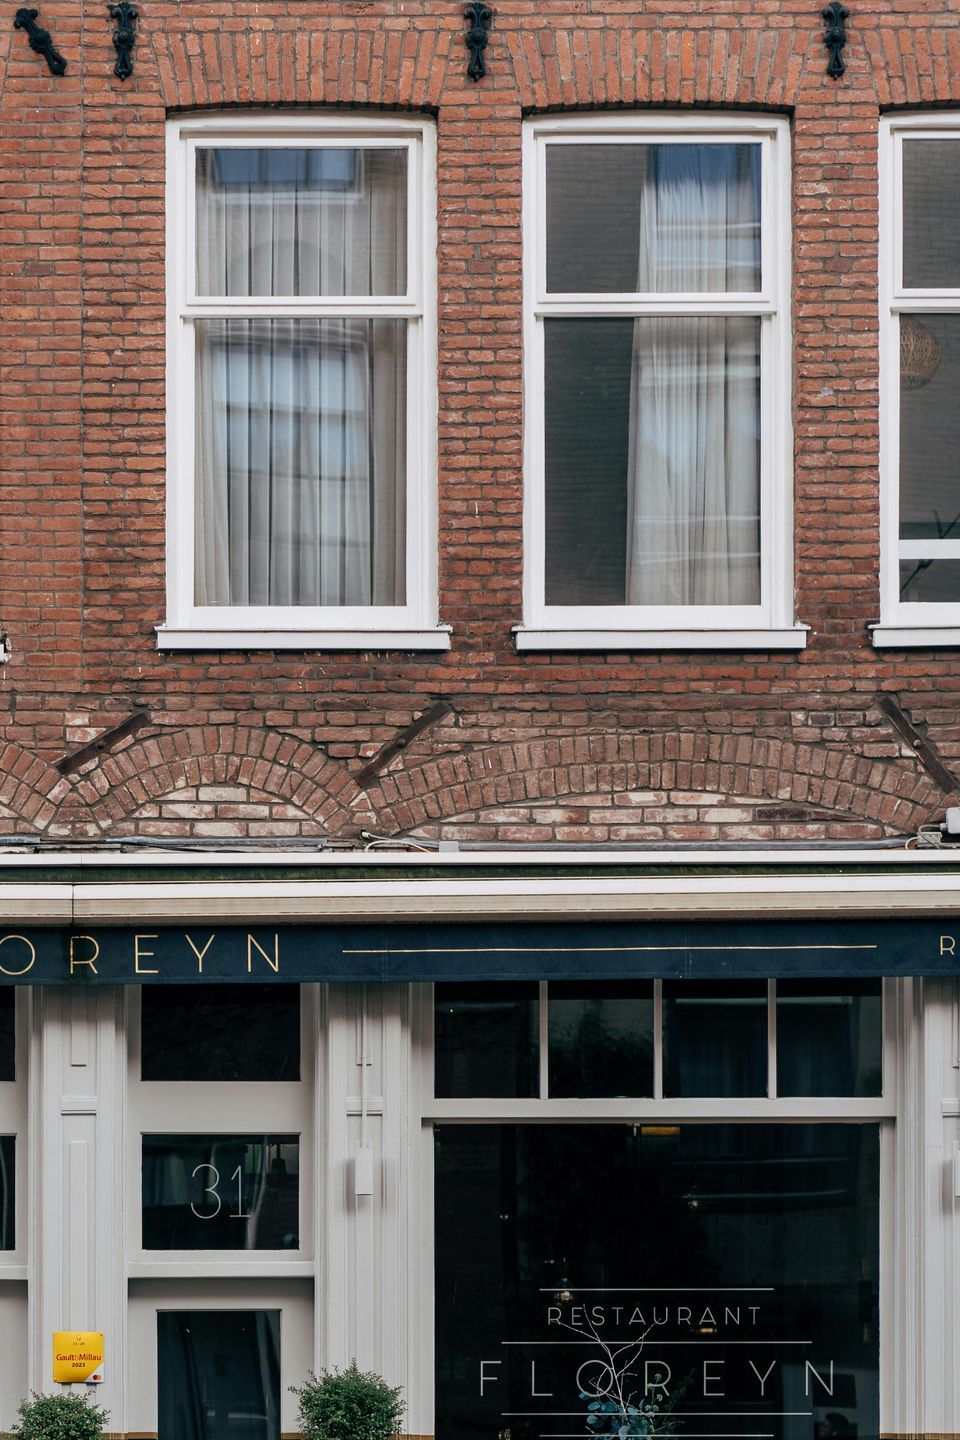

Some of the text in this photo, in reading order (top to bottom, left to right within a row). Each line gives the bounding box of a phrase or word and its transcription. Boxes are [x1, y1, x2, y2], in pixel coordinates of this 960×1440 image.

[190, 1164, 251, 1219] 31
[547, 1306, 760, 1326] RESTAURANT
[480, 1359, 834, 1398] FLOREYN
